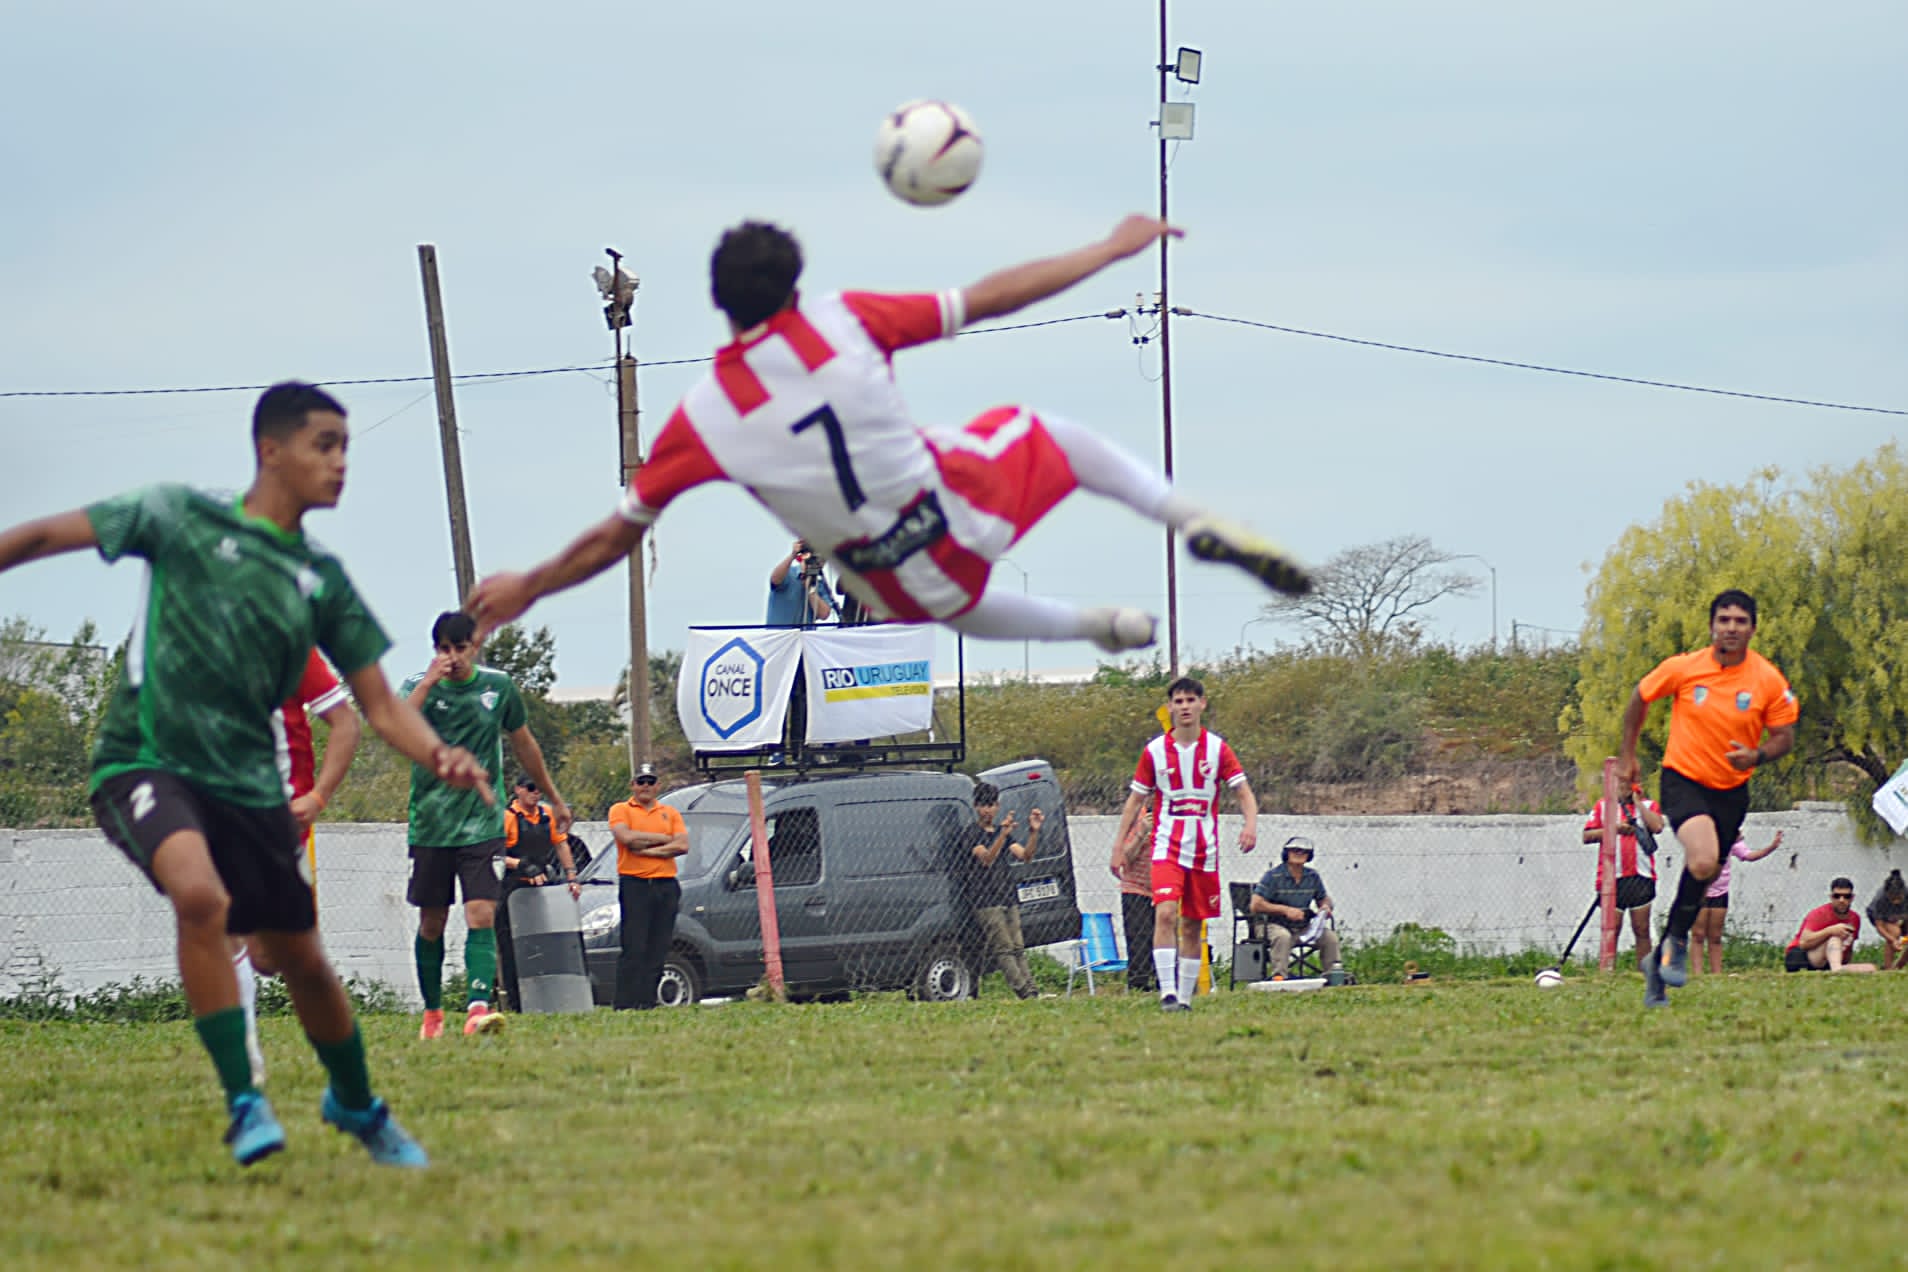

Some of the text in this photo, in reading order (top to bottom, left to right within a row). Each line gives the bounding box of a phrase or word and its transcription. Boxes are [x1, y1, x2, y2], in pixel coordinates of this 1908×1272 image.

[789, 402, 868, 514] 7
[715, 663, 746, 675] CANAL
[859, 663, 928, 685] URUGUAY
[707, 678, 751, 697] ONCE
